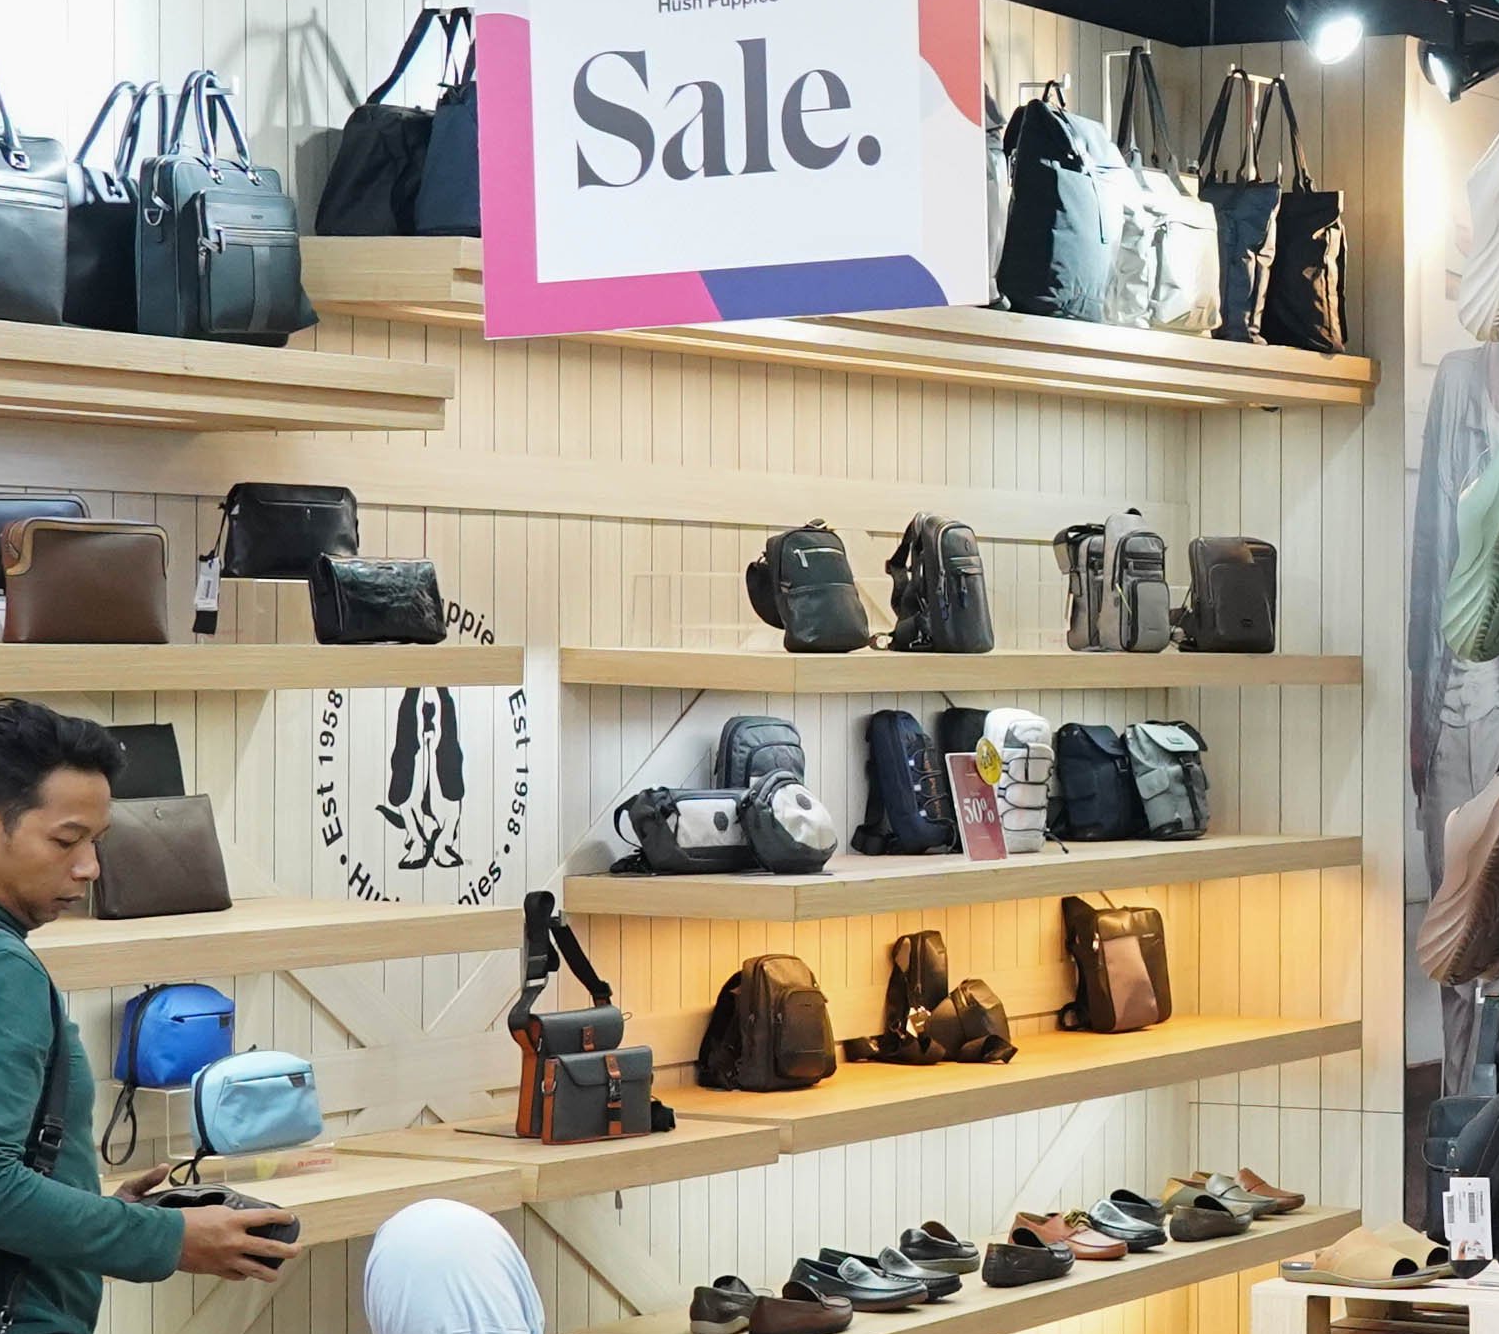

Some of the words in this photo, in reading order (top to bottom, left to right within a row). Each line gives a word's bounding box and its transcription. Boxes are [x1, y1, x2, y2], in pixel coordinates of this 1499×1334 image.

[573, 37, 883, 190] Sale.
[317, 688, 344, 765] 1958
[508, 688, 532, 748] Est
[316, 779, 345, 848] Est
[506, 766, 530, 837] 1958
